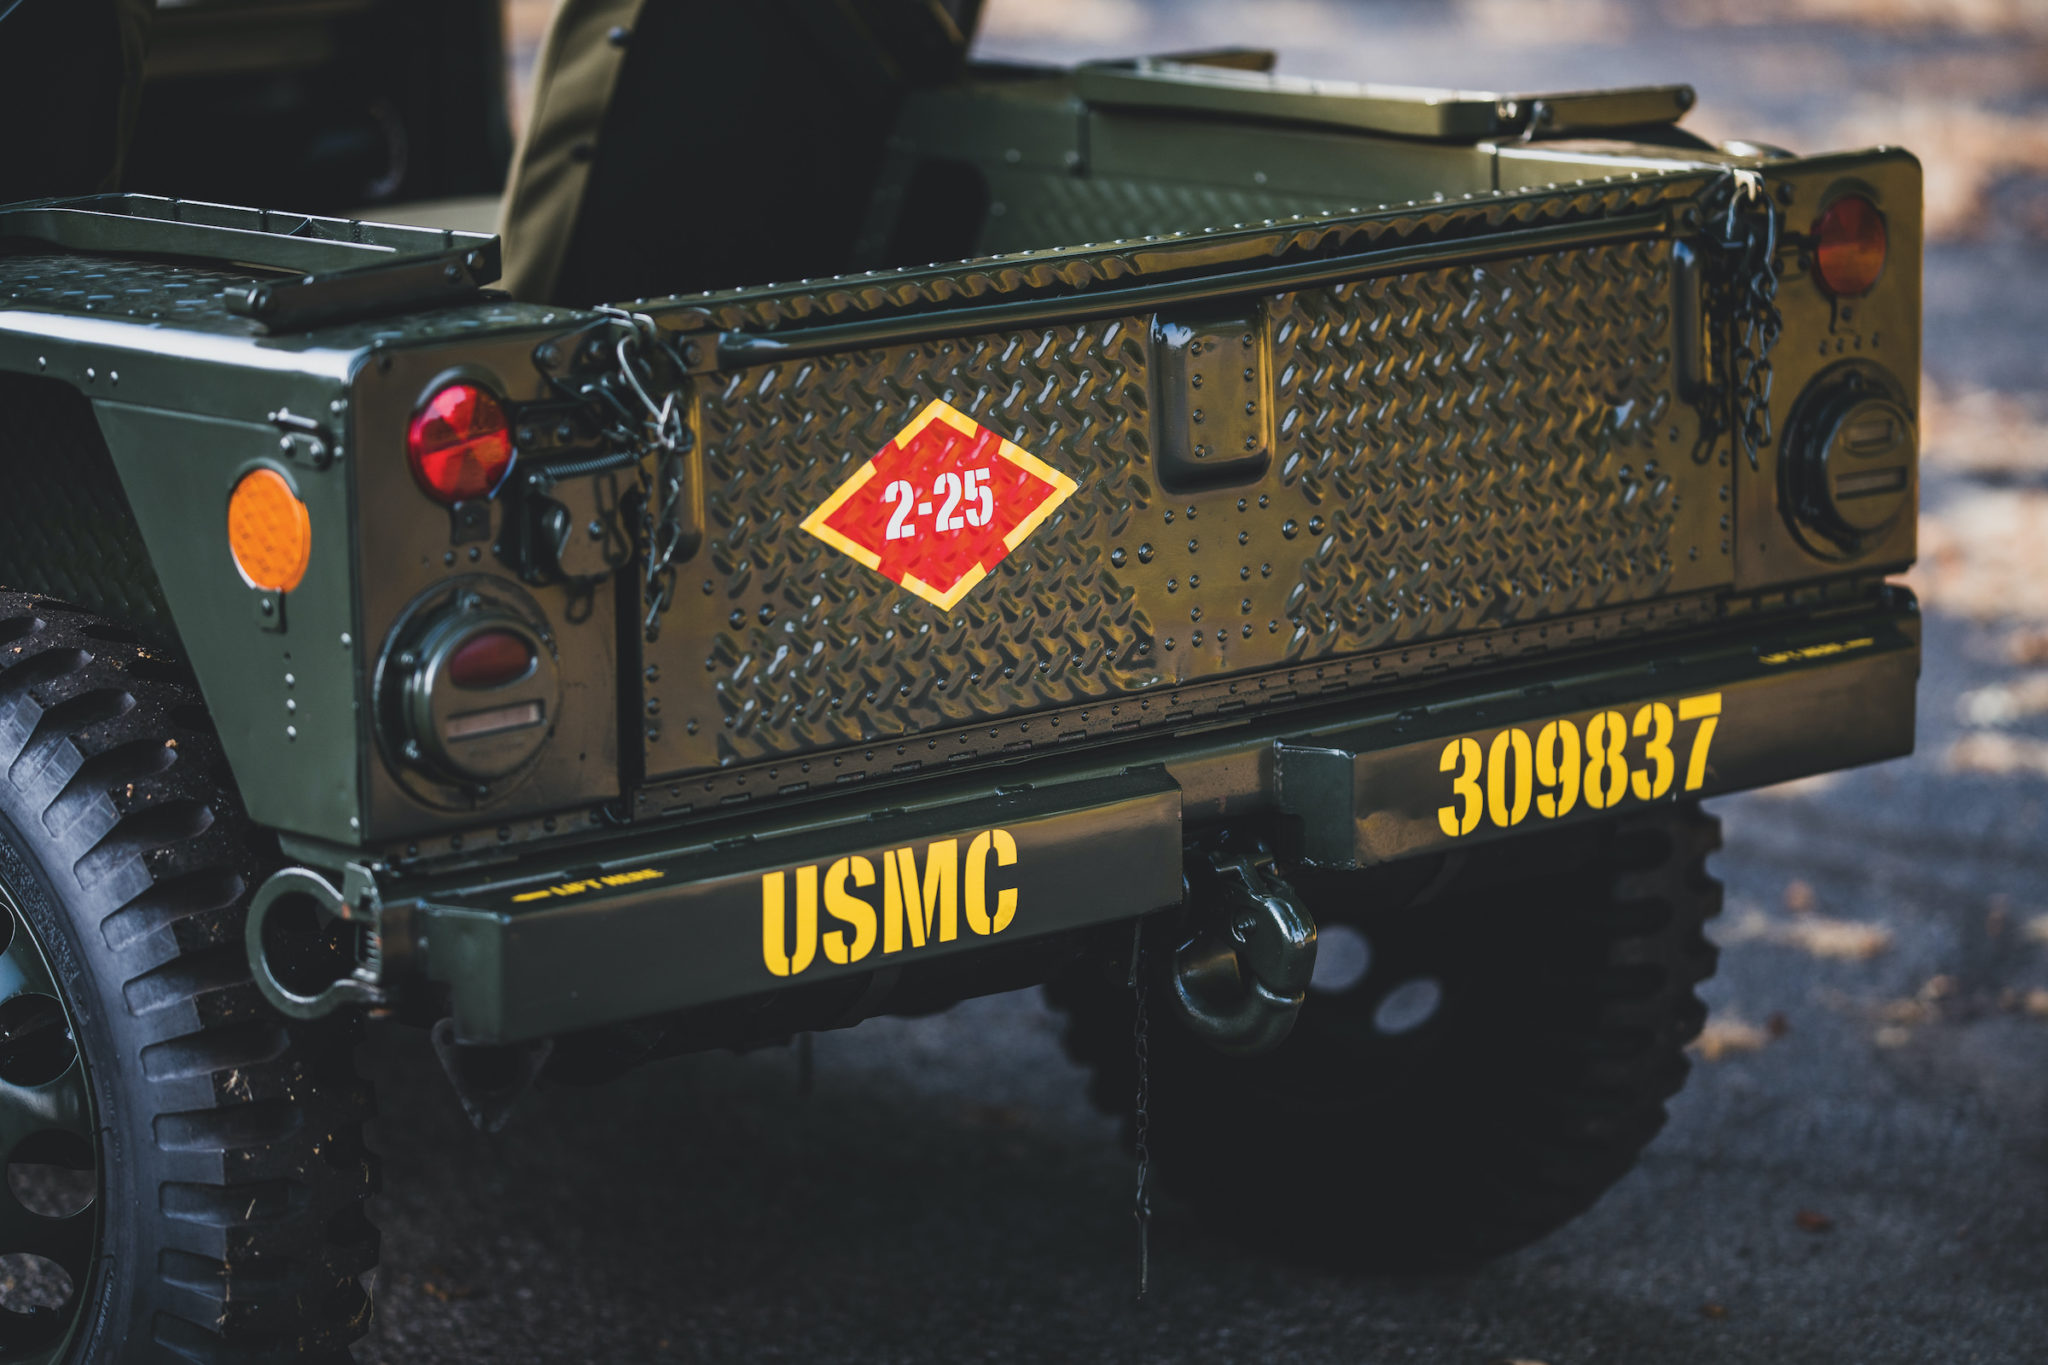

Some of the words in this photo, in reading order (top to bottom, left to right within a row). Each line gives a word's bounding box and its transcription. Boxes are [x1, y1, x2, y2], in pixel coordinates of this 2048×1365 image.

[884, 467, 994, 540] 2-25
[1438, 692, 1722, 837] 309837
[762, 829, 1018, 976] USMC
